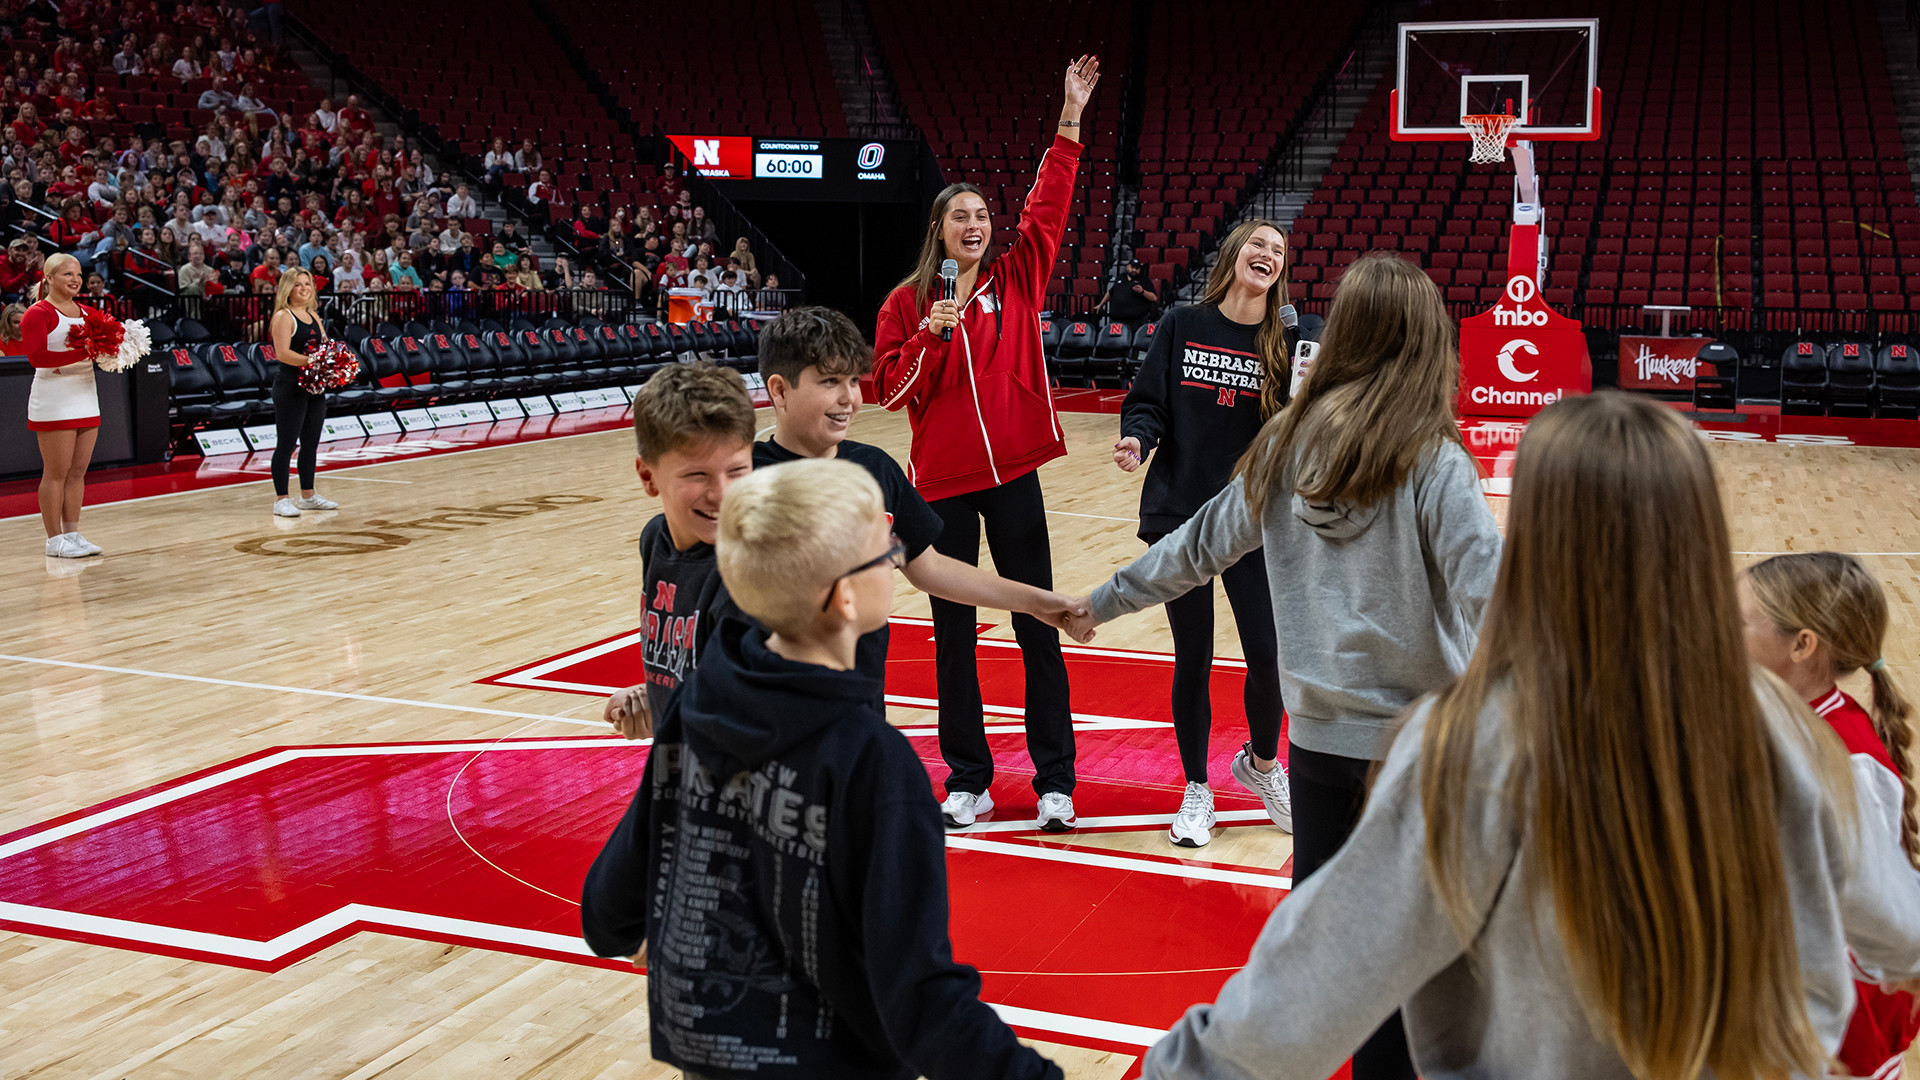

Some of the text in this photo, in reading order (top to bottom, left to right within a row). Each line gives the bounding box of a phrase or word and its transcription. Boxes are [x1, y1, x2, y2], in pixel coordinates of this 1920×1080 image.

[694, 140, 720, 166] N
[760, 143, 799, 151] COUNTDOWN
[766, 160, 812, 174] 60:00
[857, 172, 886, 180] OMAHA
[1493, 304, 1549, 327] fnbo
[1074, 323, 1086, 334] N
[1110, 323, 1122, 335] N
[371, 338, 386, 353] N
[402, 336, 418, 351] N
[1798, 343, 1813, 354] N
[1844, 344, 1859, 356] N
[172, 348, 193, 366] N
[219, 345, 238, 362] N
[1891, 345, 1906, 357] N
[1183, 348, 1265, 376] NEBRASK
[1634, 344, 1702, 384] Huskers
[1217, 387, 1236, 407] N
[1471, 386, 1563, 406] Channel
[439, 412, 461, 421] BECK'S
[467, 408, 490, 417] BECK'S
[373, 419, 396, 428] BECK'S
[409, 416, 430, 424] BECK'S
[335, 423, 361, 432] BECK'S
[212, 436, 243, 447] BECK'S
[653, 580, 677, 612] N
[652, 822, 677, 919] VARSITY
